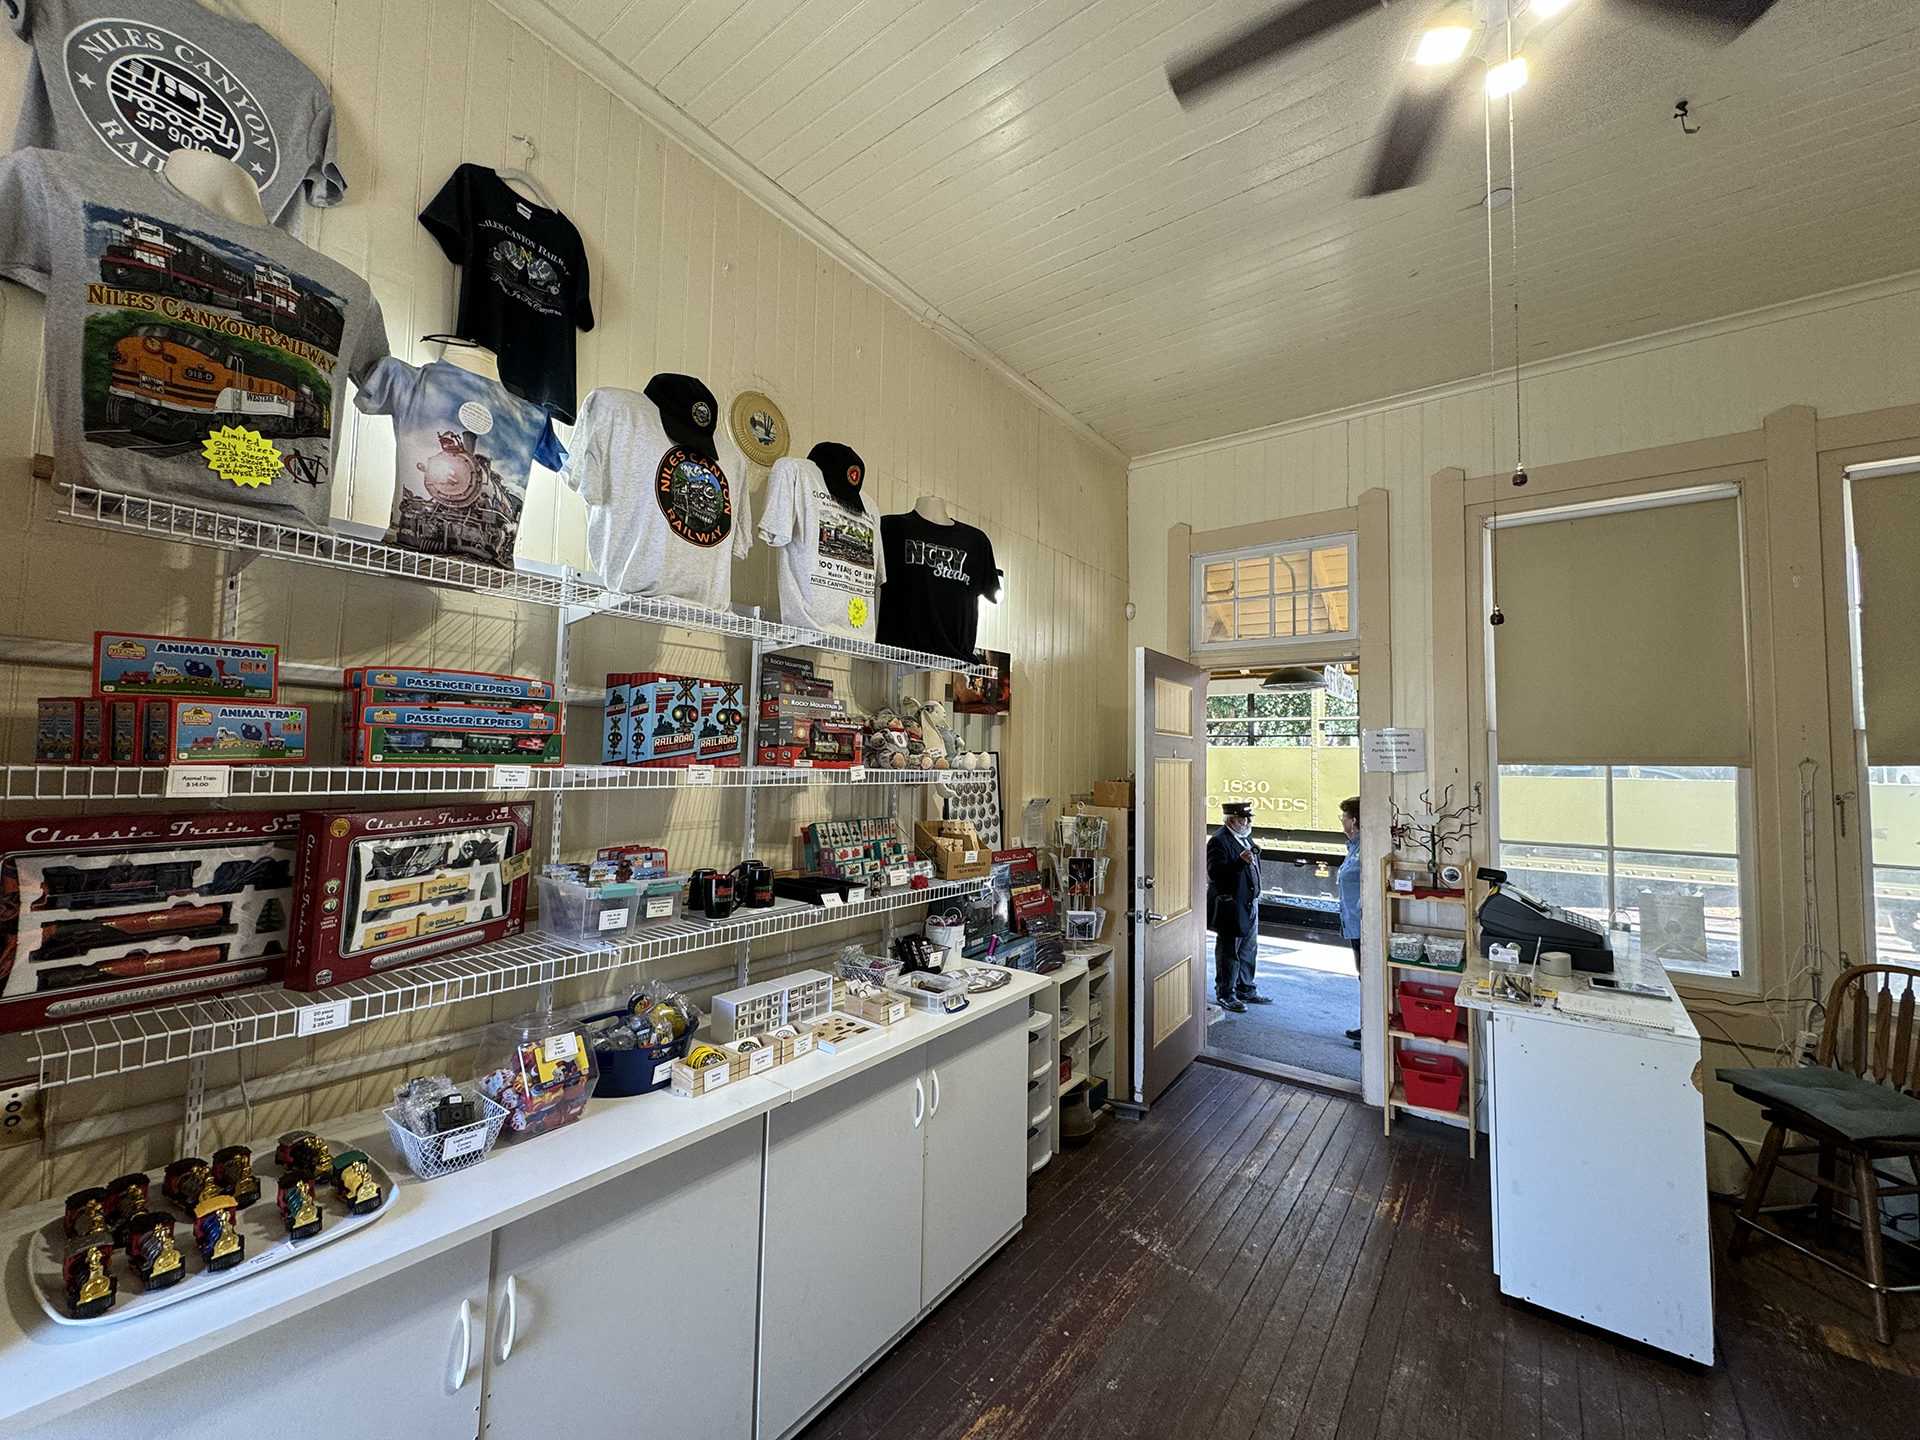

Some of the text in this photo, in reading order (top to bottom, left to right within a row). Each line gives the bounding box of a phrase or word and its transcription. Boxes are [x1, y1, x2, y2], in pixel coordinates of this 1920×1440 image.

[78, 27, 272, 153] NILES CANYON
[136, 111, 166, 132] SP
[505, 225, 536, 248] CANYON
[86, 284, 337, 374] NILES CANYON RAILWAY
[213, 440, 236, 451] Only
[222, 430, 260, 447] Limited
[234, 463, 254, 473] Long
[660, 450, 732, 515] NILES CANYON
[666, 507, 722, 543] RAILWAY
[905, 539, 967, 571] NCRY
[933, 562, 970, 586] Steam
[810, 577, 827, 585] NILES
[827, 580, 849, 590] CANYON
[155, 642, 268, 659] ANIMAL TRAIN
[406, 678, 521, 695] PASSENGER EXPRESS
[219, 708, 265, 719] ANIMAL
[791, 700, 808, 708] ROCKY
[810, 701, 837, 710] MOUNTAIN
[405, 713, 523, 729] PASSENGER EXPRESS
[654, 734, 694, 747] RAILROAD
[700, 735, 738, 748] RAILROAD
[1223, 779, 1270, 794] 1830
[365, 817, 434, 831] Classic
[438, 811, 482, 826] Train
[25, 817, 300, 844] Classic Train Se
[438, 882, 459, 891] Global
[435, 916, 456, 925] Global
[58, 1003, 72, 1012] 20
[79, 997, 110, 1009] PIECE
[115, 987, 158, 1002] BATTERY
